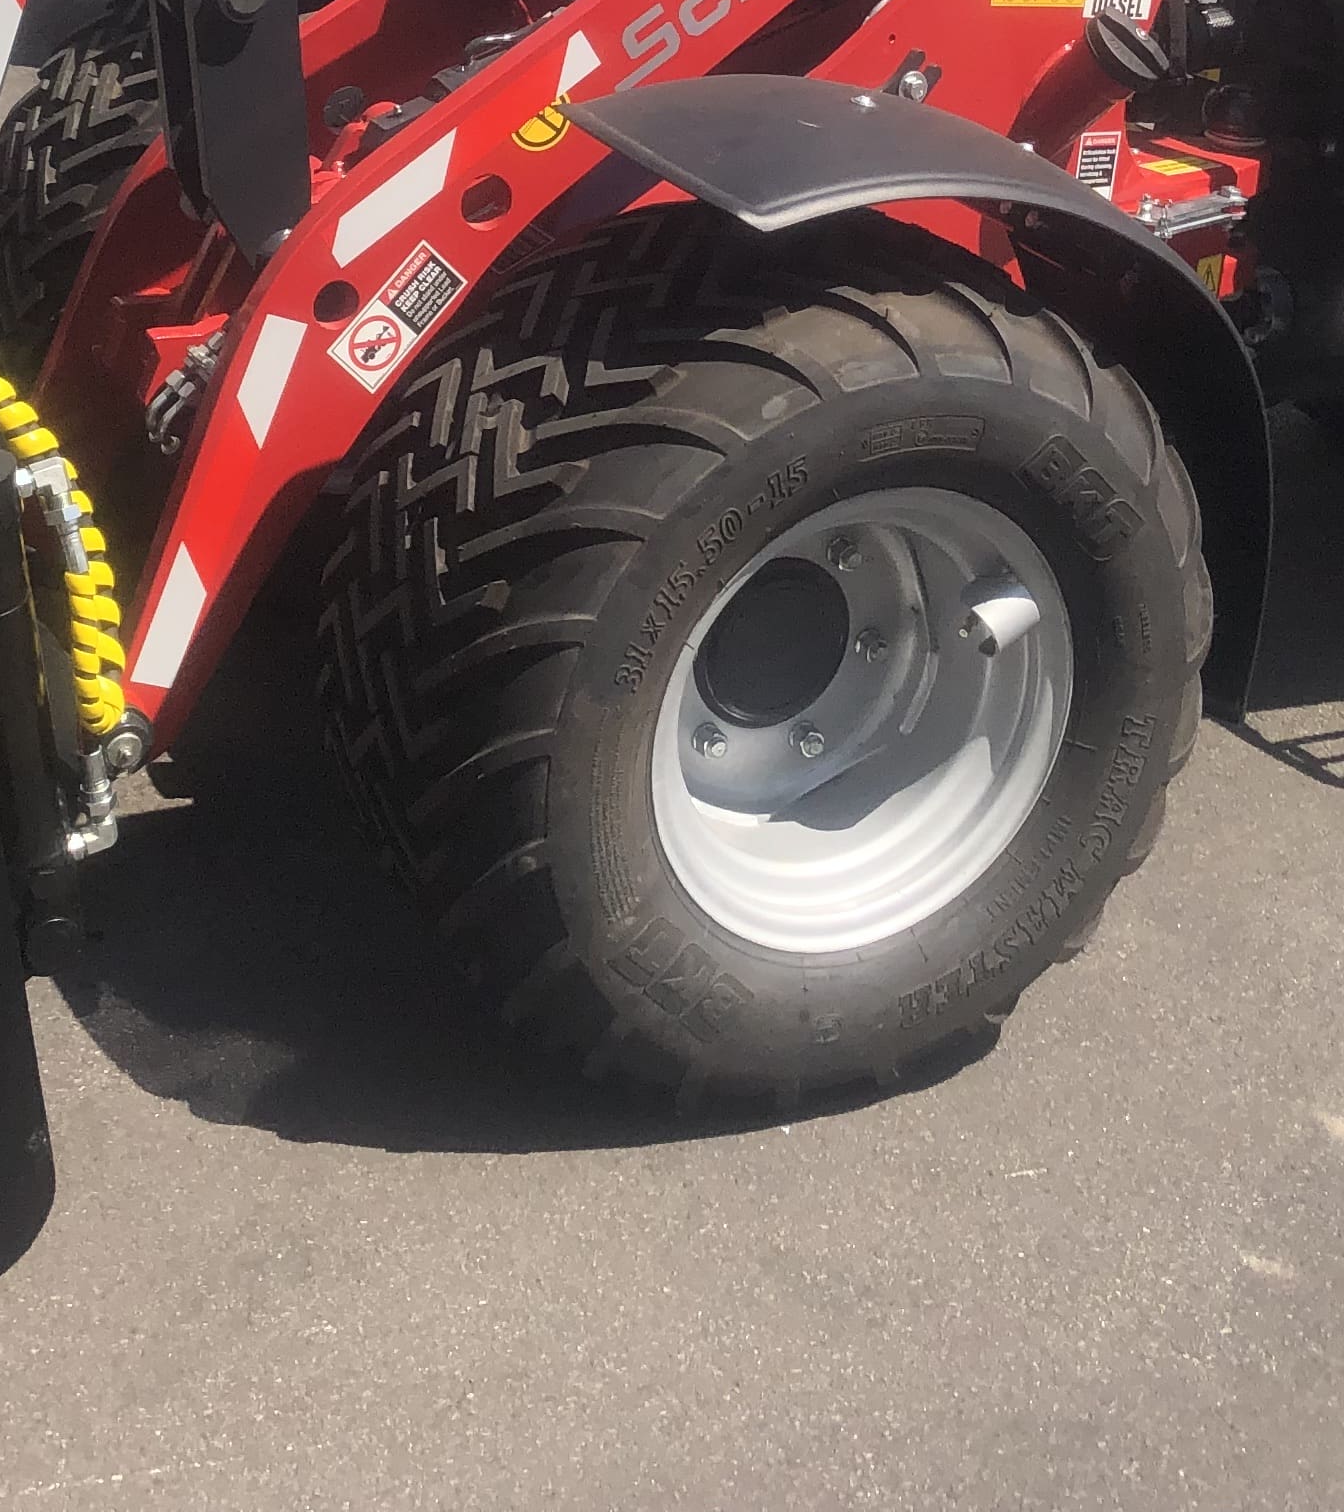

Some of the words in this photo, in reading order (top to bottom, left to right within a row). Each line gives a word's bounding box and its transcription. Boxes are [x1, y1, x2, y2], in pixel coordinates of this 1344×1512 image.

[394, 252, 427, 288] DANGER
[395, 279, 418, 307] CRUSH
[417, 260, 436, 281] RISK
[400, 290, 419, 312] KEEP
[419, 266, 442, 291] CLEAR
[1014, 434, 1146, 562] BKT
[1079, 713, 1157, 863] TRAC
[898, 857, 1085, 1029] MASTER
